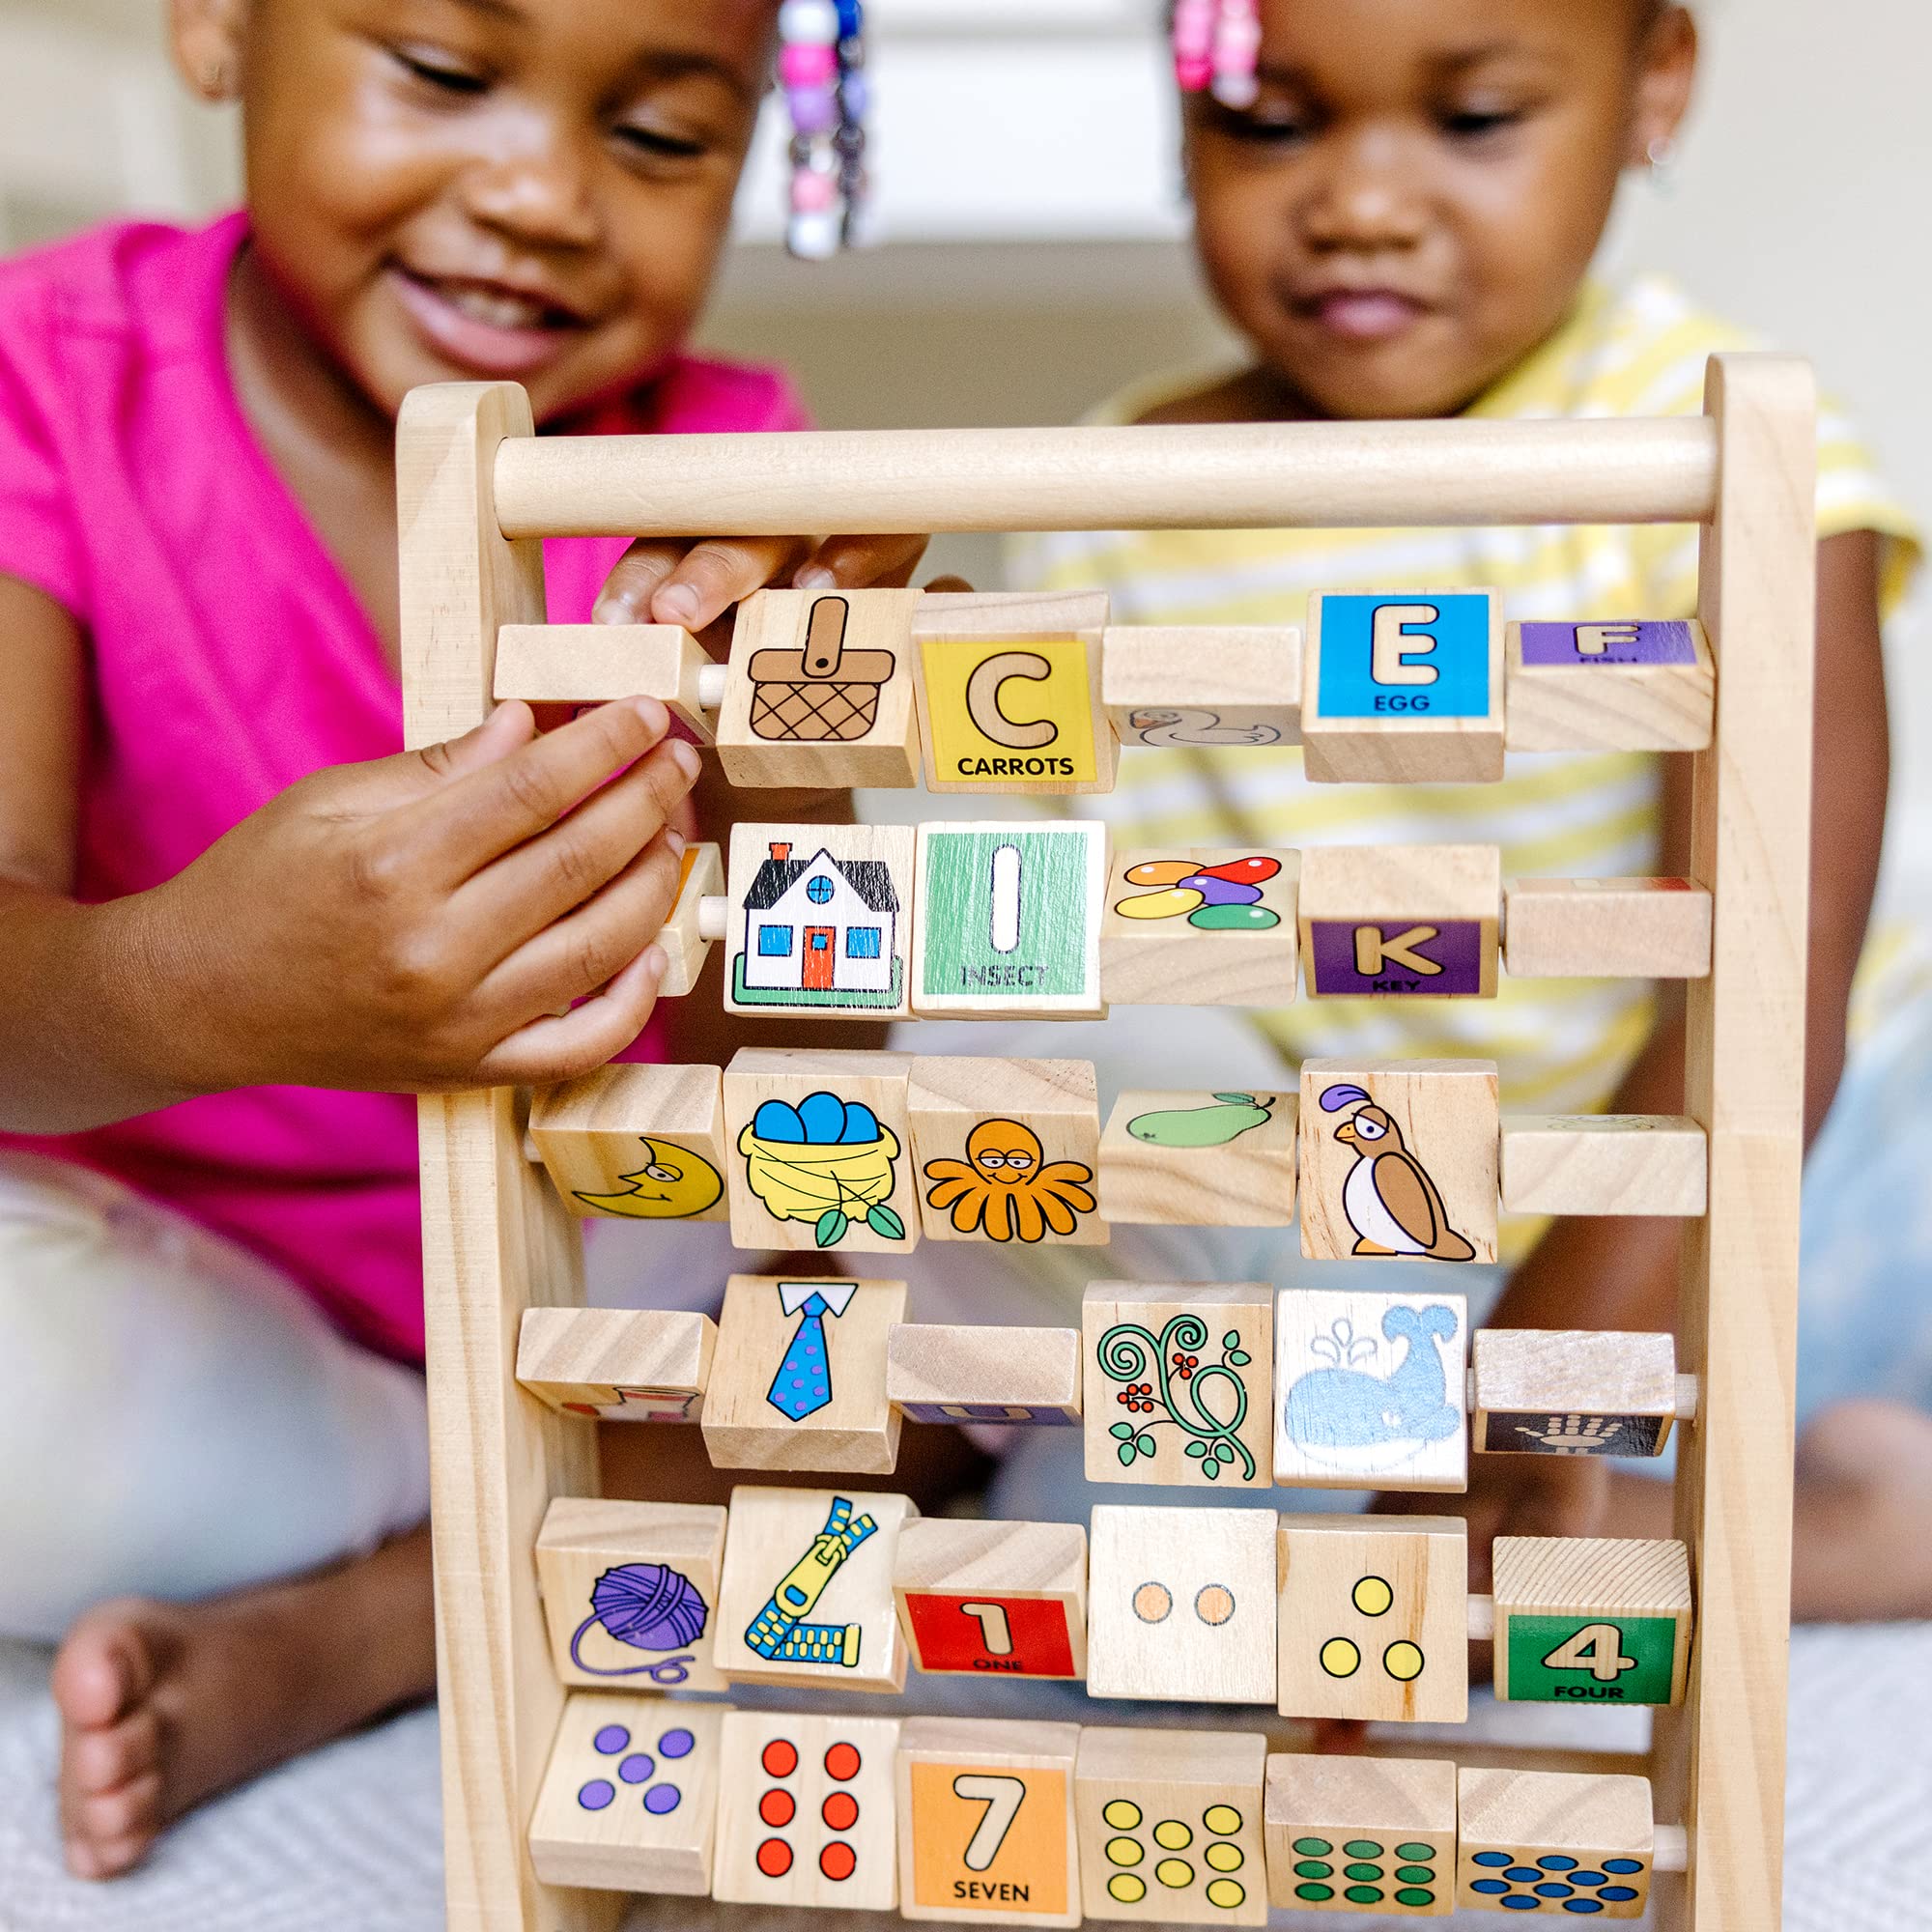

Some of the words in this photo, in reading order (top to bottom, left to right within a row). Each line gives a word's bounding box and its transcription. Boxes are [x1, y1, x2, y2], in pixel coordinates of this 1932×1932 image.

[1371, 603, 1439, 687] E
[1573, 625, 1641, 655] F
[966, 651, 1058, 750] C
[1374, 695, 1430, 712] EGG
[957, 757, 1074, 776] CARROTS
[989, 843, 1022, 954] I
[1354, 925, 1446, 977] K
[961, 965, 1049, 987] INSECT
[1373, 980, 1421, 992] KEY
[959, 1602, 1013, 1656] 1
[973, 1659, 1024, 1670] ONE
[1541, 1623, 1638, 1682] 4
[1554, 1686, 1624, 1699] FOUR
[952, 1774, 1026, 1872] 7
[953, 1881, 1030, 1902] SEVEN
